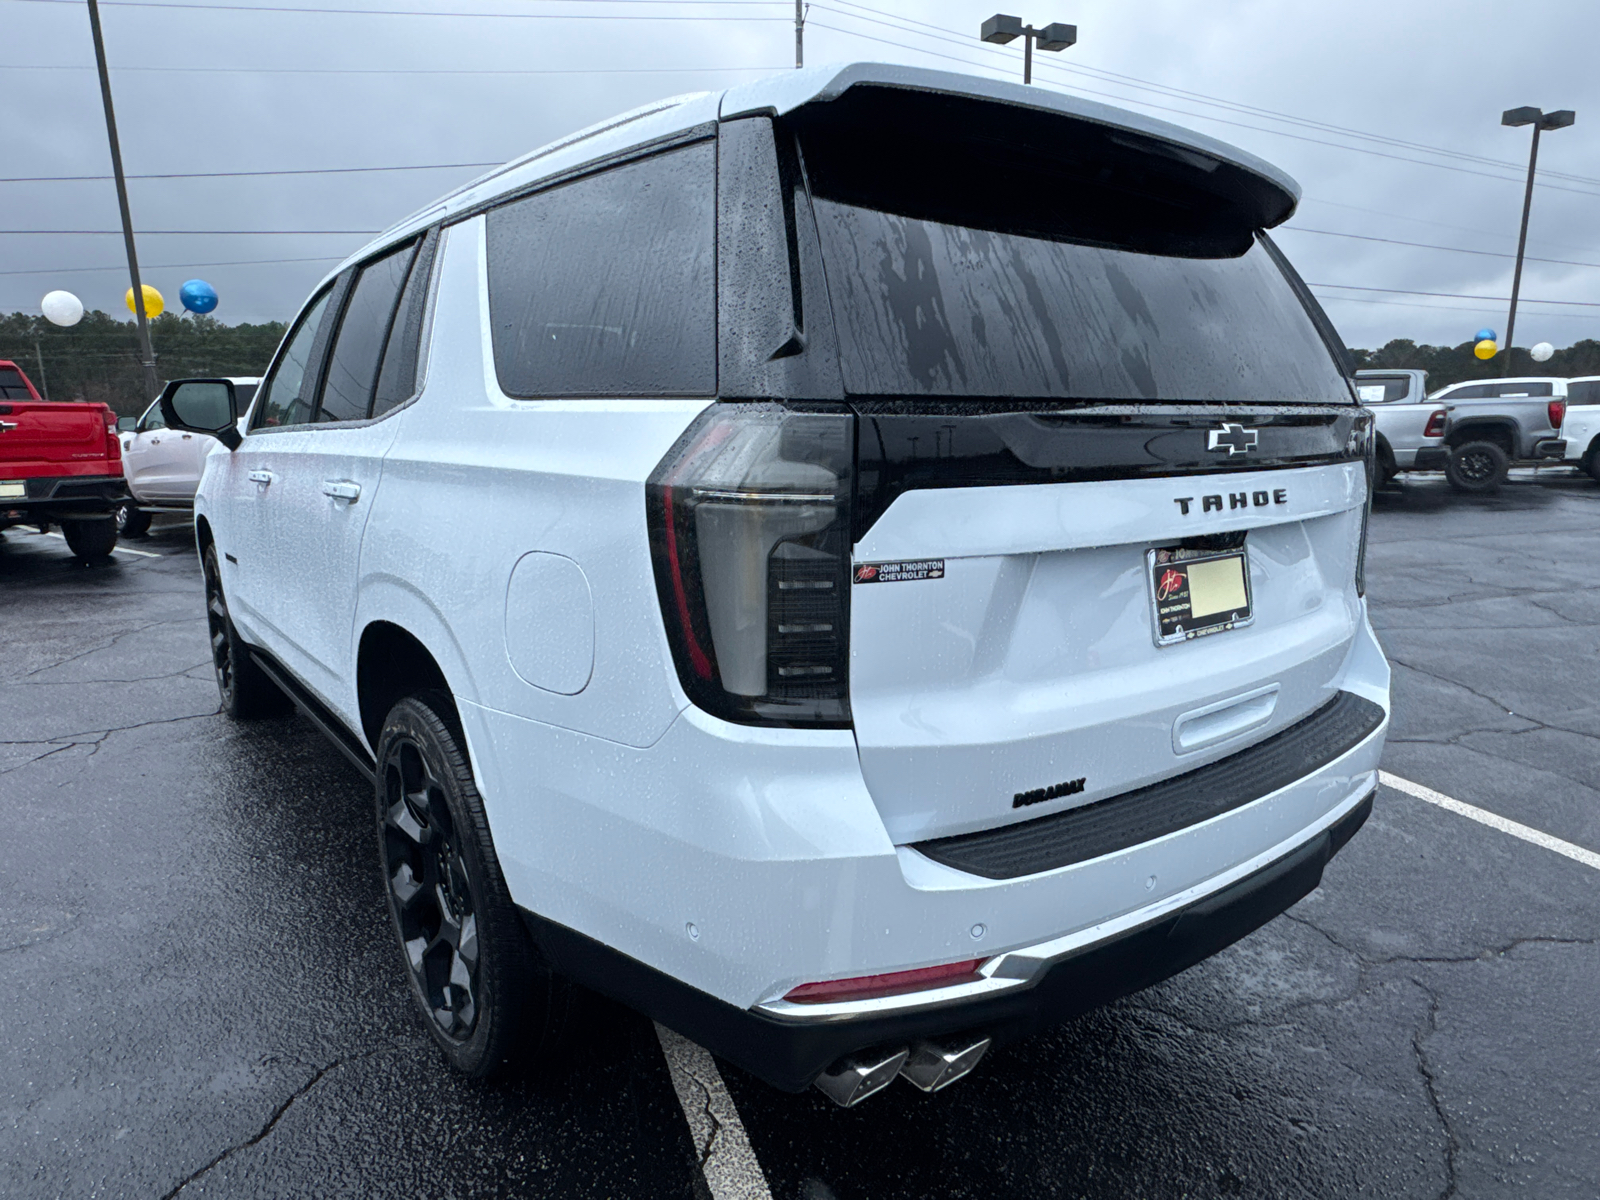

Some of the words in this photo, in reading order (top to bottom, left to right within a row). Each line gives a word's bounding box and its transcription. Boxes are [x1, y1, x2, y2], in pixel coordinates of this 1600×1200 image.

[1173, 488, 1288, 515] TAHOE
[879, 563, 900, 573] JOHN
[902, 561, 943, 572] THORNTON
[879, 571, 928, 581] CHEVROLET
